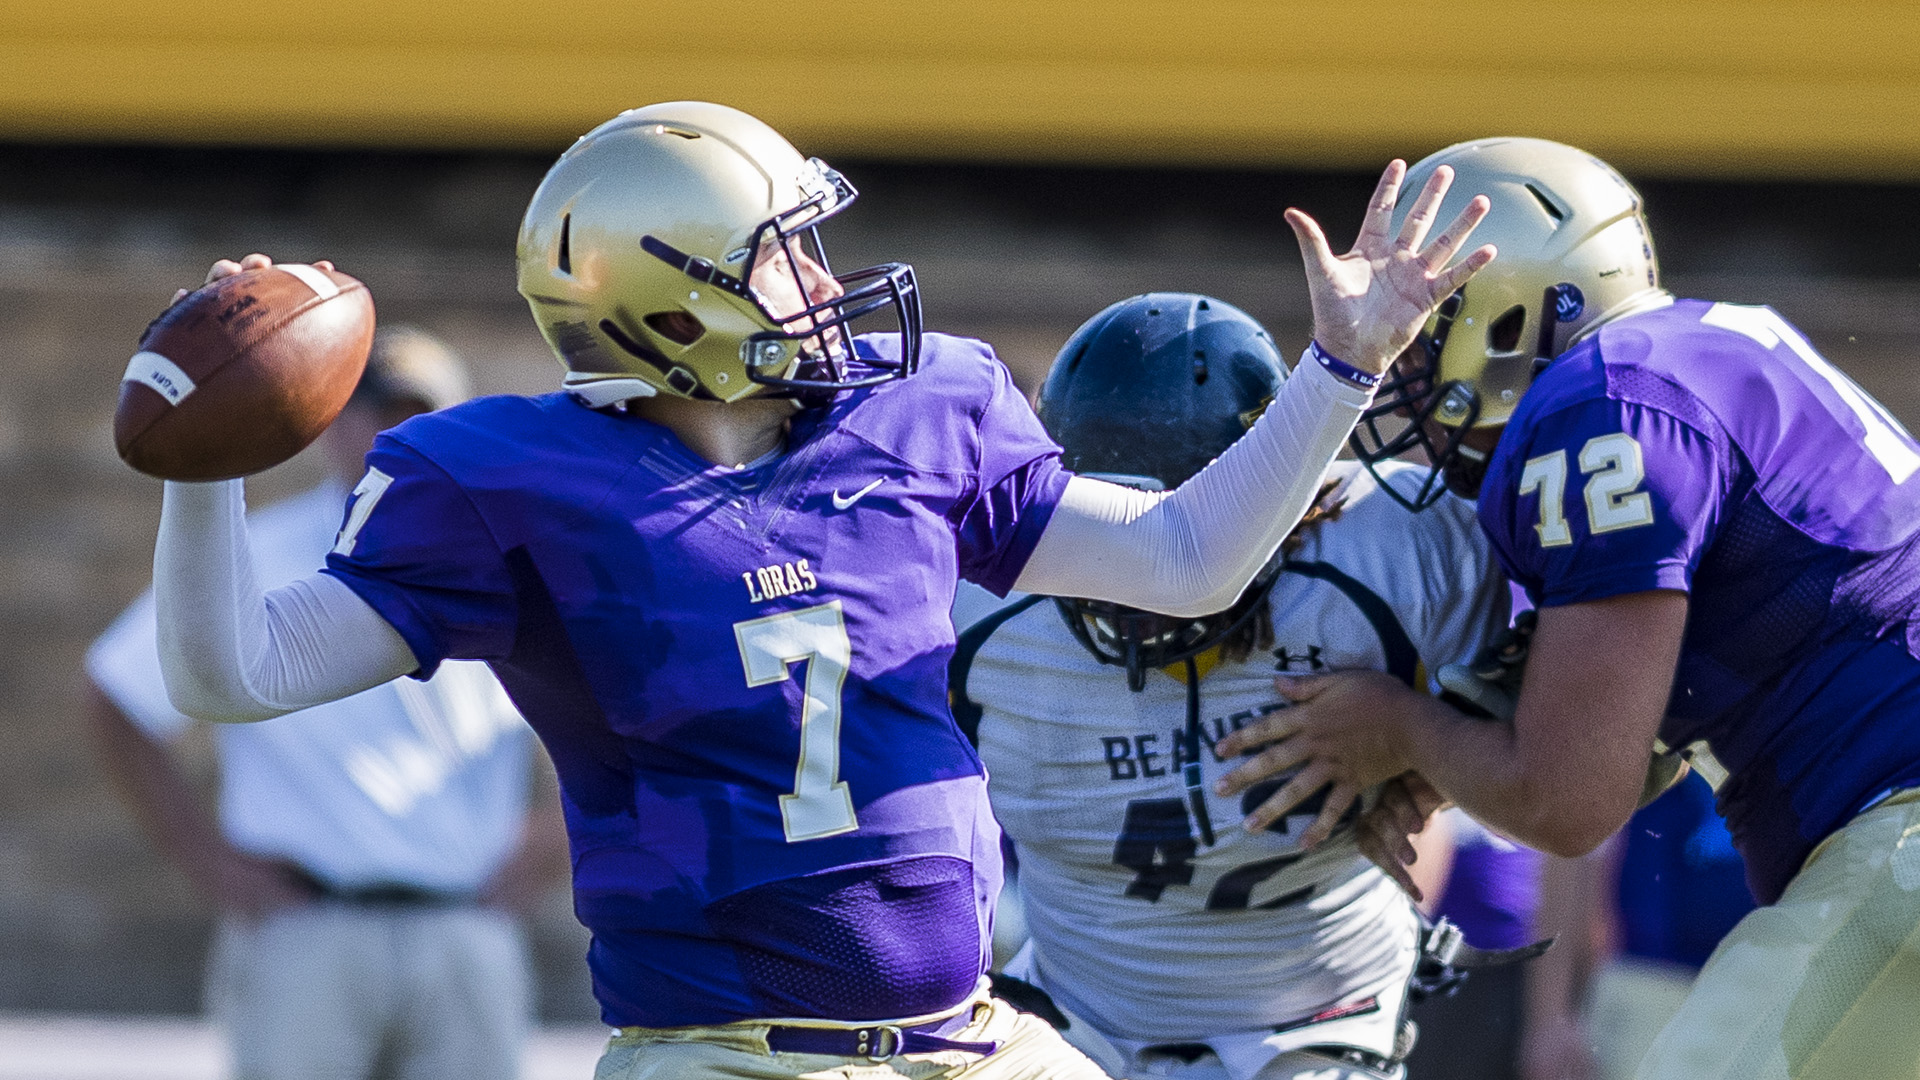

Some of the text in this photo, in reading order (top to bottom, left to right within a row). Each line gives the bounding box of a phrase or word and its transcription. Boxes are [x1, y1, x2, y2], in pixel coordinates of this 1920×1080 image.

[332, 466, 395, 557] 7
[1519, 432, 1655, 547] 72
[742, 558, 818, 603] LORAS
[733, 600, 859, 843] 7
[1112, 774, 1363, 910] 42
